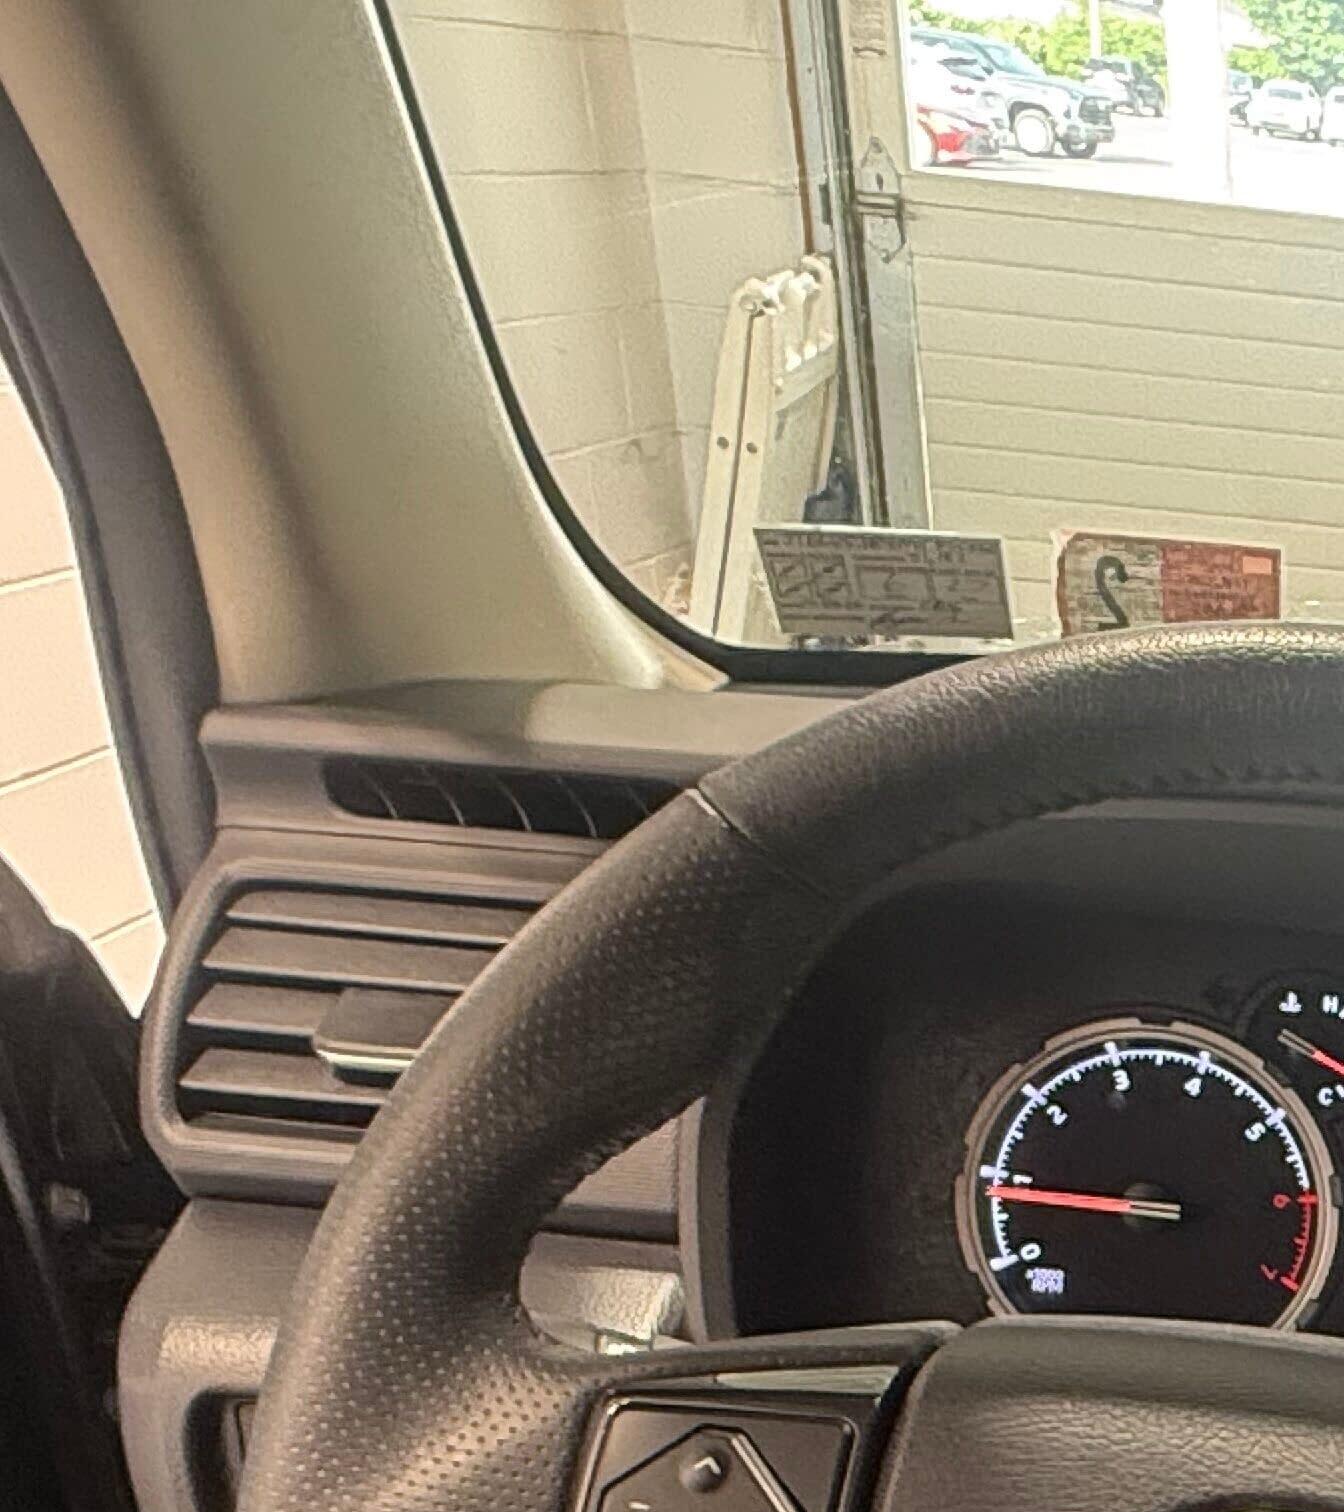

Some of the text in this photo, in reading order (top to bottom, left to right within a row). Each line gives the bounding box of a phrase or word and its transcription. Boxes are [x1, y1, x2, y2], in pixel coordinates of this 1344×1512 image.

[1323, 995, 1339, 1014] H
[1114, 1069, 1132, 1092] 3
[1184, 1078, 1203, 1098] 4
[1046, 1104, 1069, 1126] 2
[1244, 1121, 1265, 1143] 5
[1012, 1173, 1034, 1186] 1
[1020, 1242, 1042, 1260] 0
